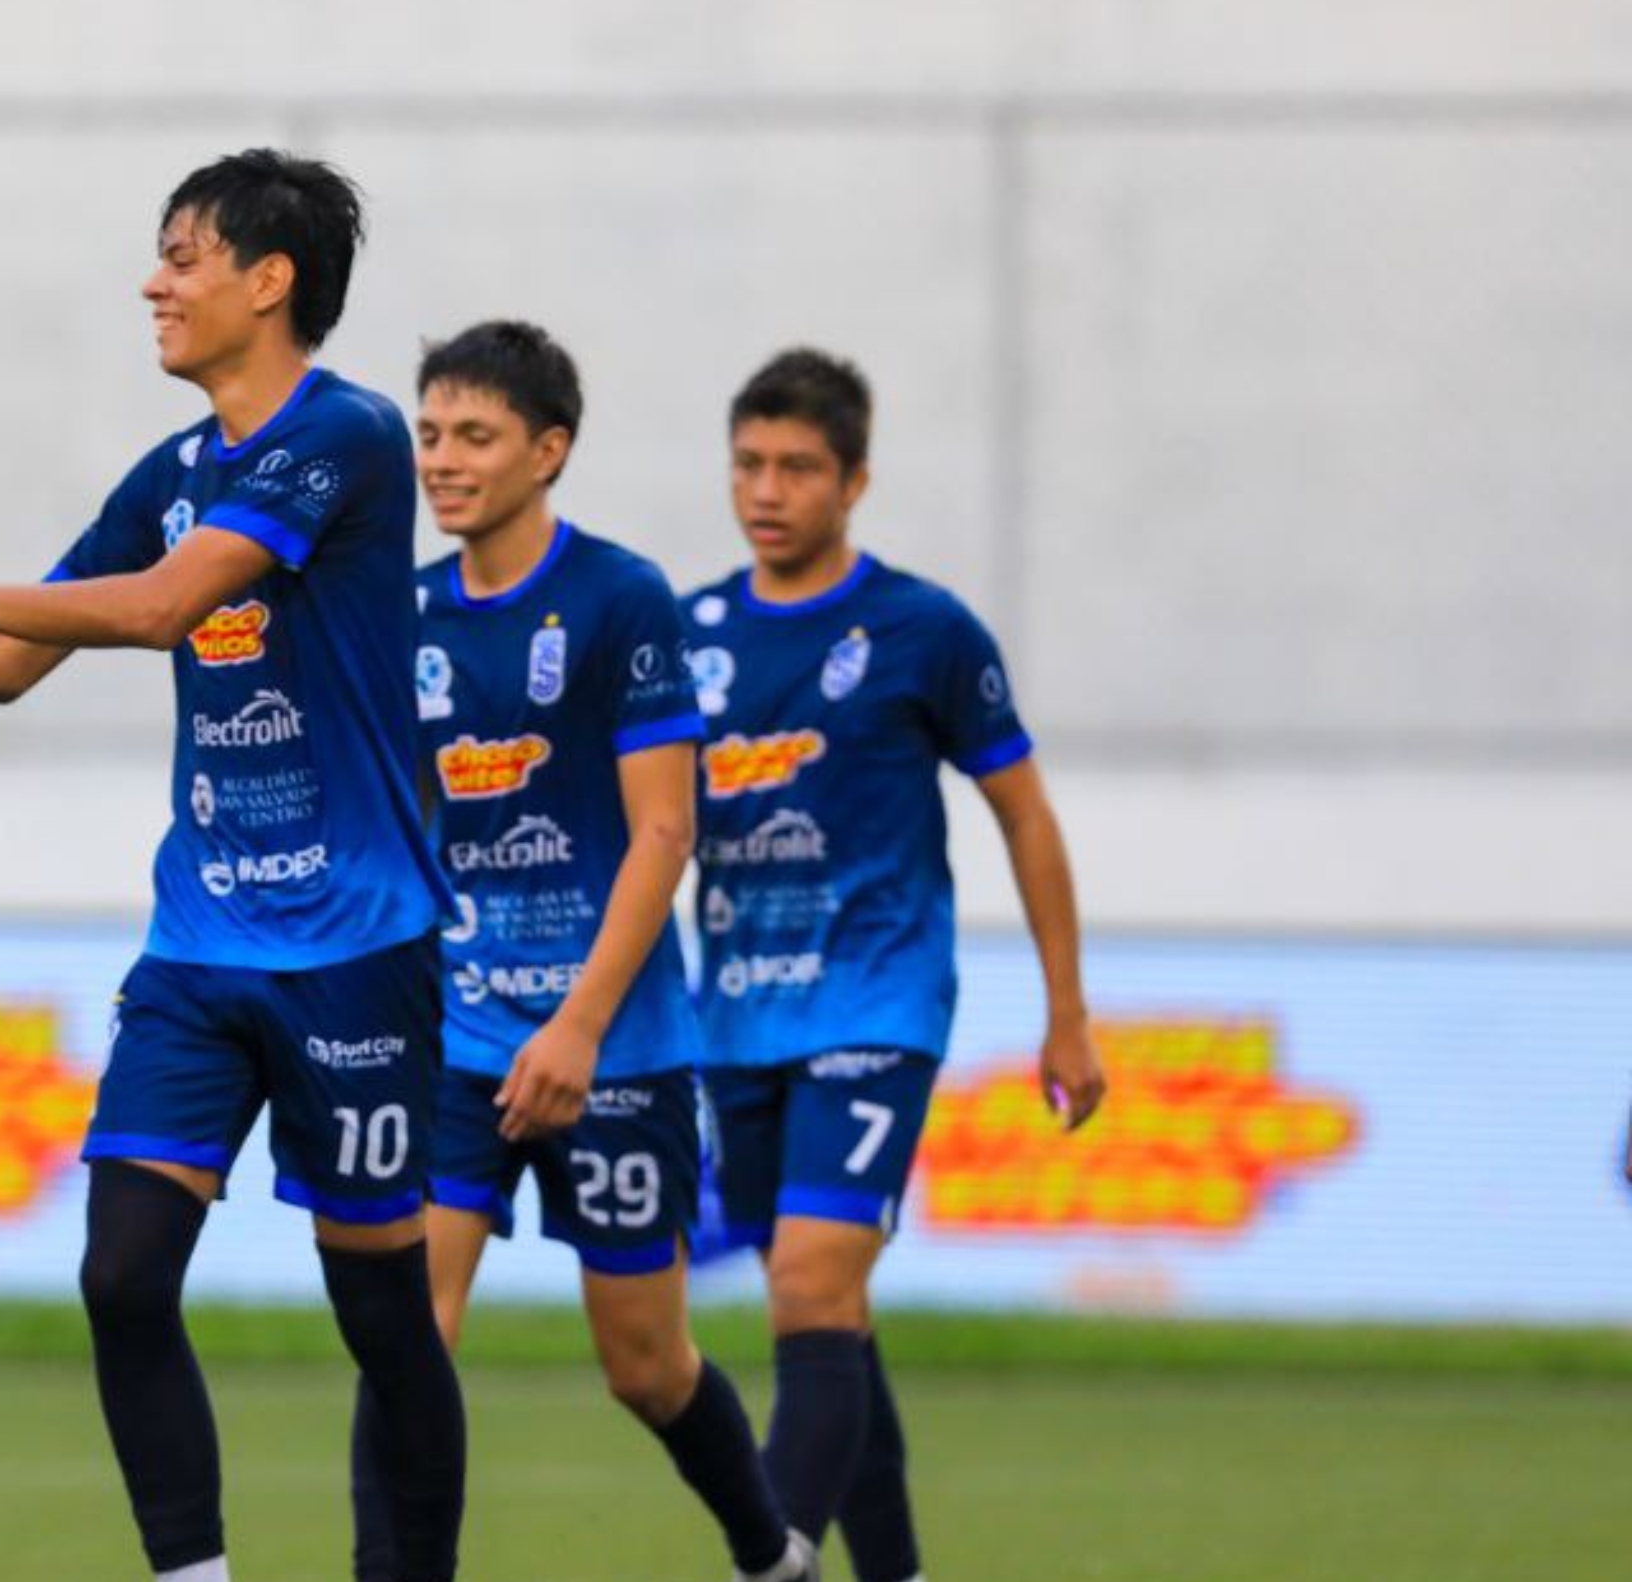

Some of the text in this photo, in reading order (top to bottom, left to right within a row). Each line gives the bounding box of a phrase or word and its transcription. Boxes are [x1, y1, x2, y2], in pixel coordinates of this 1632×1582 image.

[193, 706, 304, 747] Electrolit
[237, 844, 331, 882] IMDER
[333, 1103, 409, 1180] 10
[844, 1099, 896, 1175] 7
[570, 1149, 661, 1228] 29
